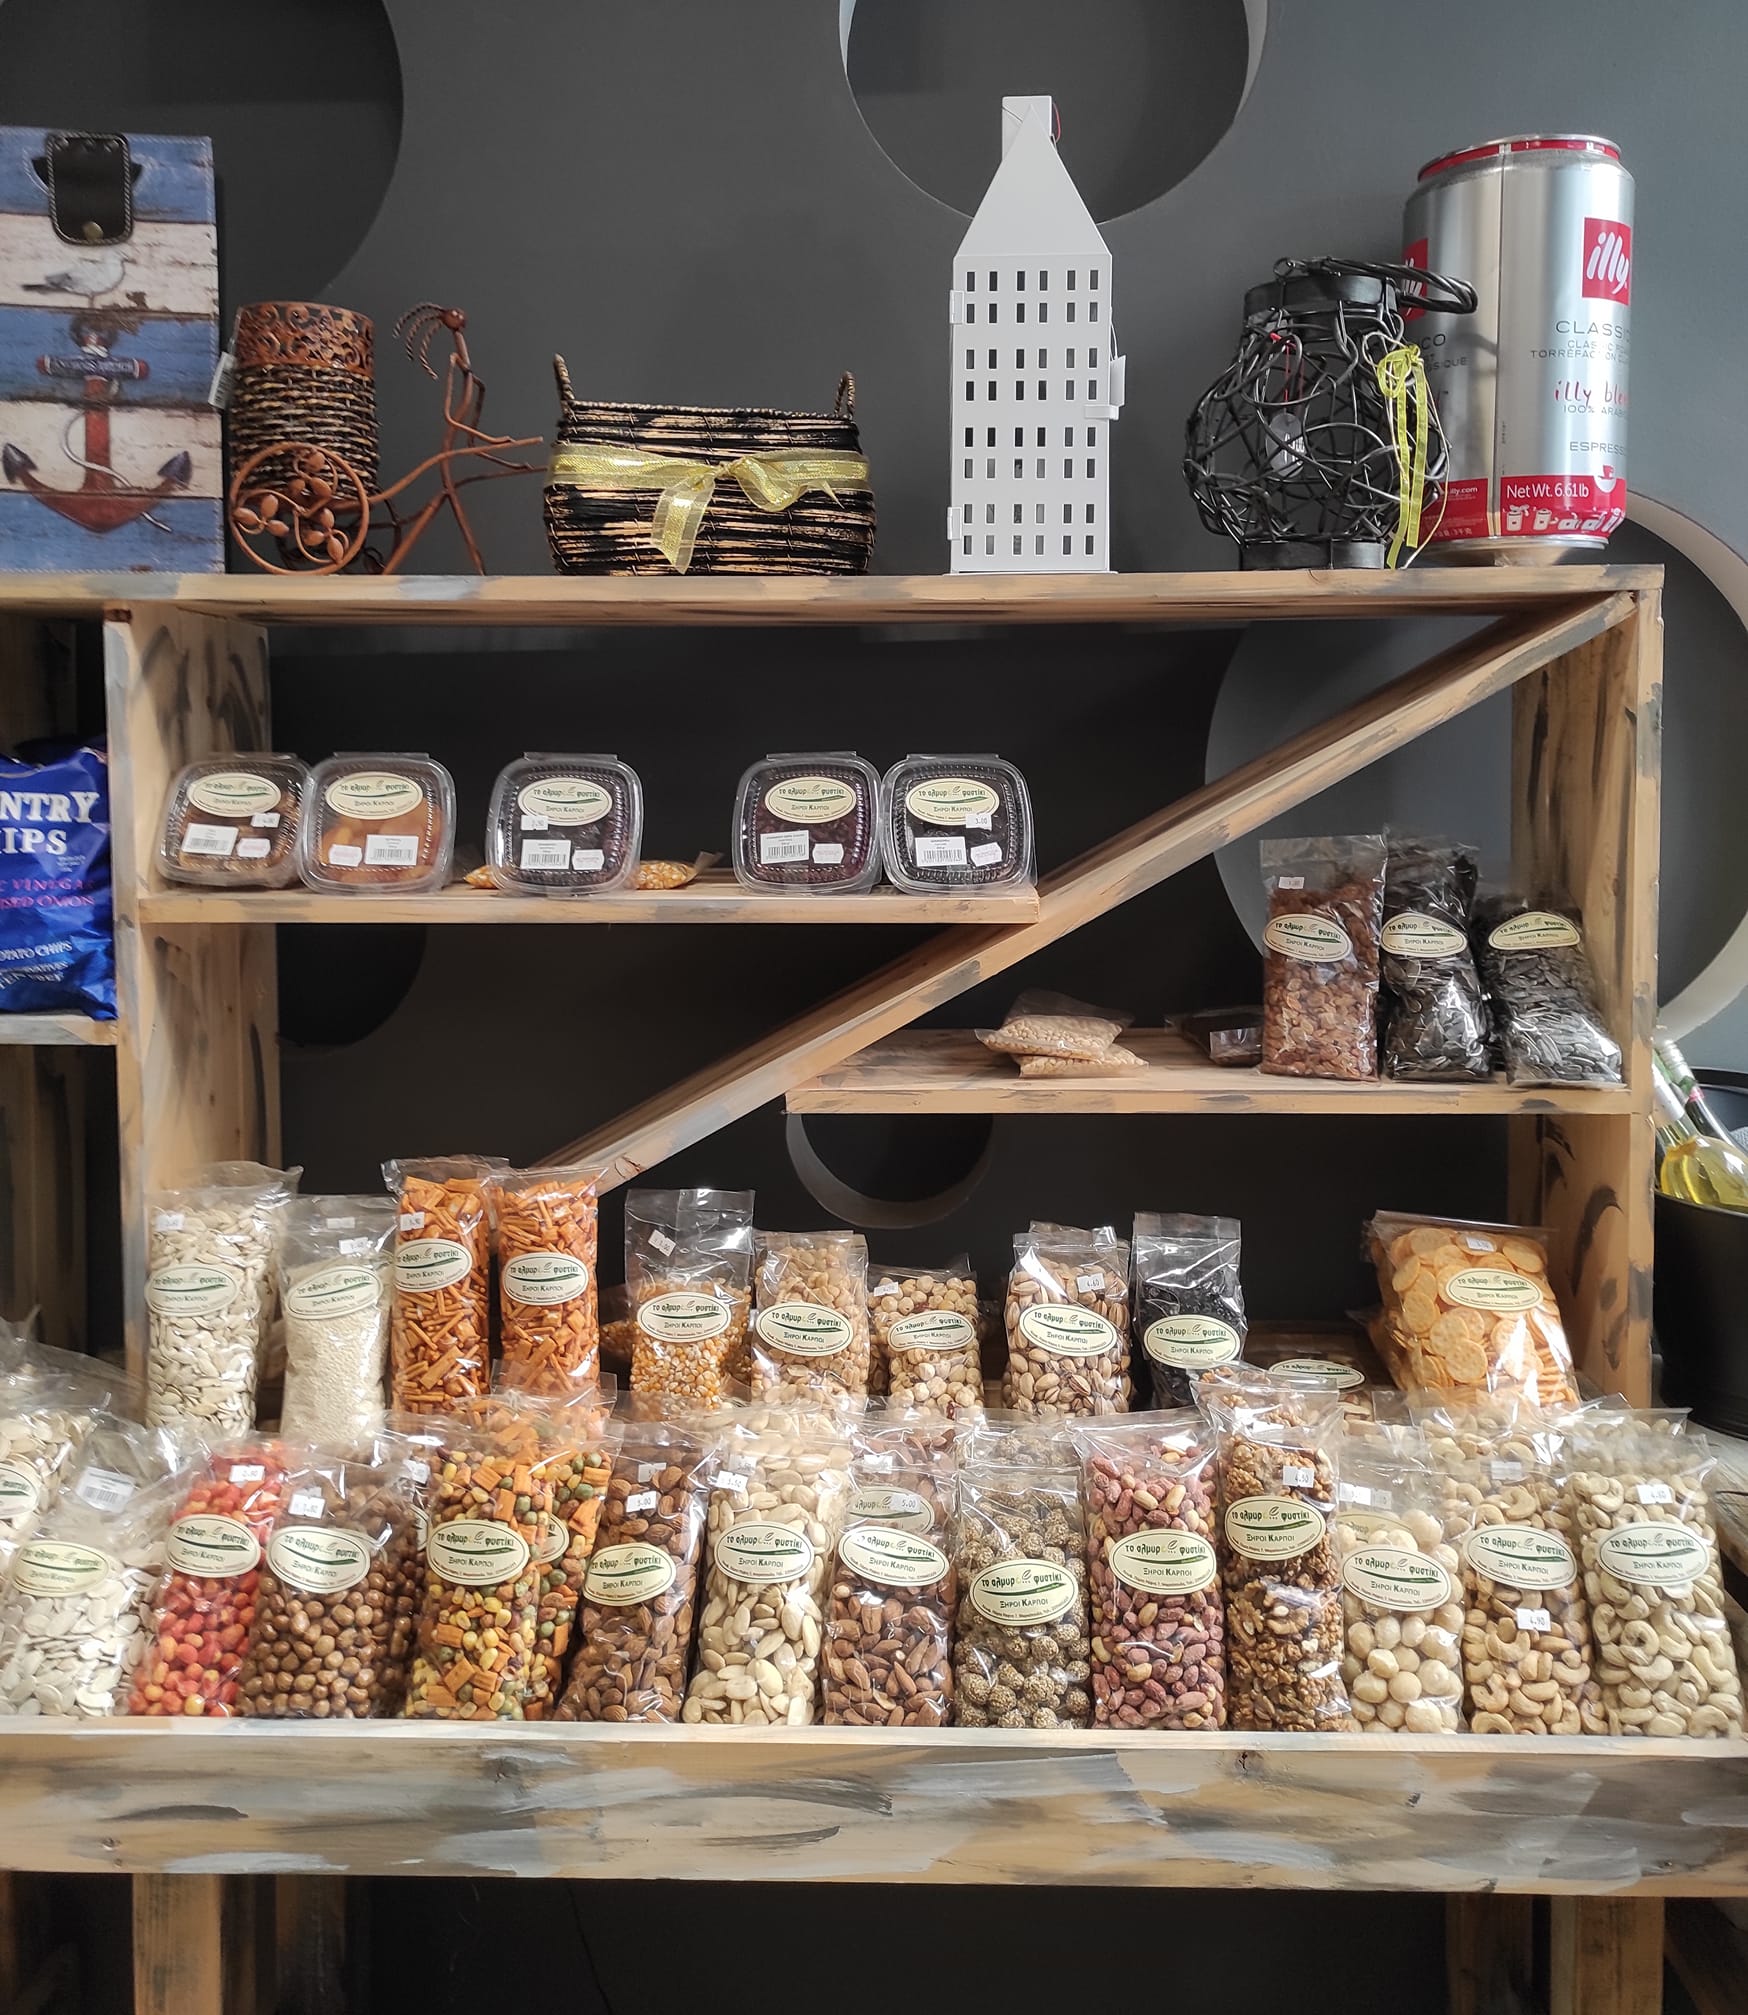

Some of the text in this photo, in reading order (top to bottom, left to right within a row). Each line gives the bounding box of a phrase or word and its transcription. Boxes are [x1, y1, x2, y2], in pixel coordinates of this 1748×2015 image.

[1587, 231, 1629, 294] illy
[1554, 380, 1592, 407] illy
[1563, 404, 1596, 414] 100%
[1506, 484, 1530, 499] Net
[1532, 483, 1551, 498] Wt.
[0, 791, 100, 824] NTRY
[1232, 1511, 1238, 1519] το
[1281, 1511, 1310, 1522] φυστίκι
[775, 1538, 802, 1549] φυστίκι
[1246, 1533, 1295, 1542] ΞΗΡΟΙ ΚΑΡΠΟΙ
[1480, 1536, 1489, 1544] το
[907, 1546, 935, 1558] φυστίκι
[1125, 1544, 1134, 1552] το
[1180, 1544, 1206, 1556] φυστίκι
[890, 1561, 916, 1573] ΚΑΡΠΟΙ
[1143, 1567, 1192, 1577] ΞΗΡΟΙ ΚΑΡΠΟΙ
[1354, 1557, 1363, 1565] το
[1409, 1565, 1438, 1577] φυστίκι
[982, 1578, 990, 1587] το
[1034, 1571, 1062, 1584] φυστίκι
[1371, 1580, 1421, 1596] ΞΗΡΟΙ ΚΑΡΠΟΙ
[1000, 1598, 1048, 1609] ΞΗΡΟΙ ΚΑΡΠΟΙ
